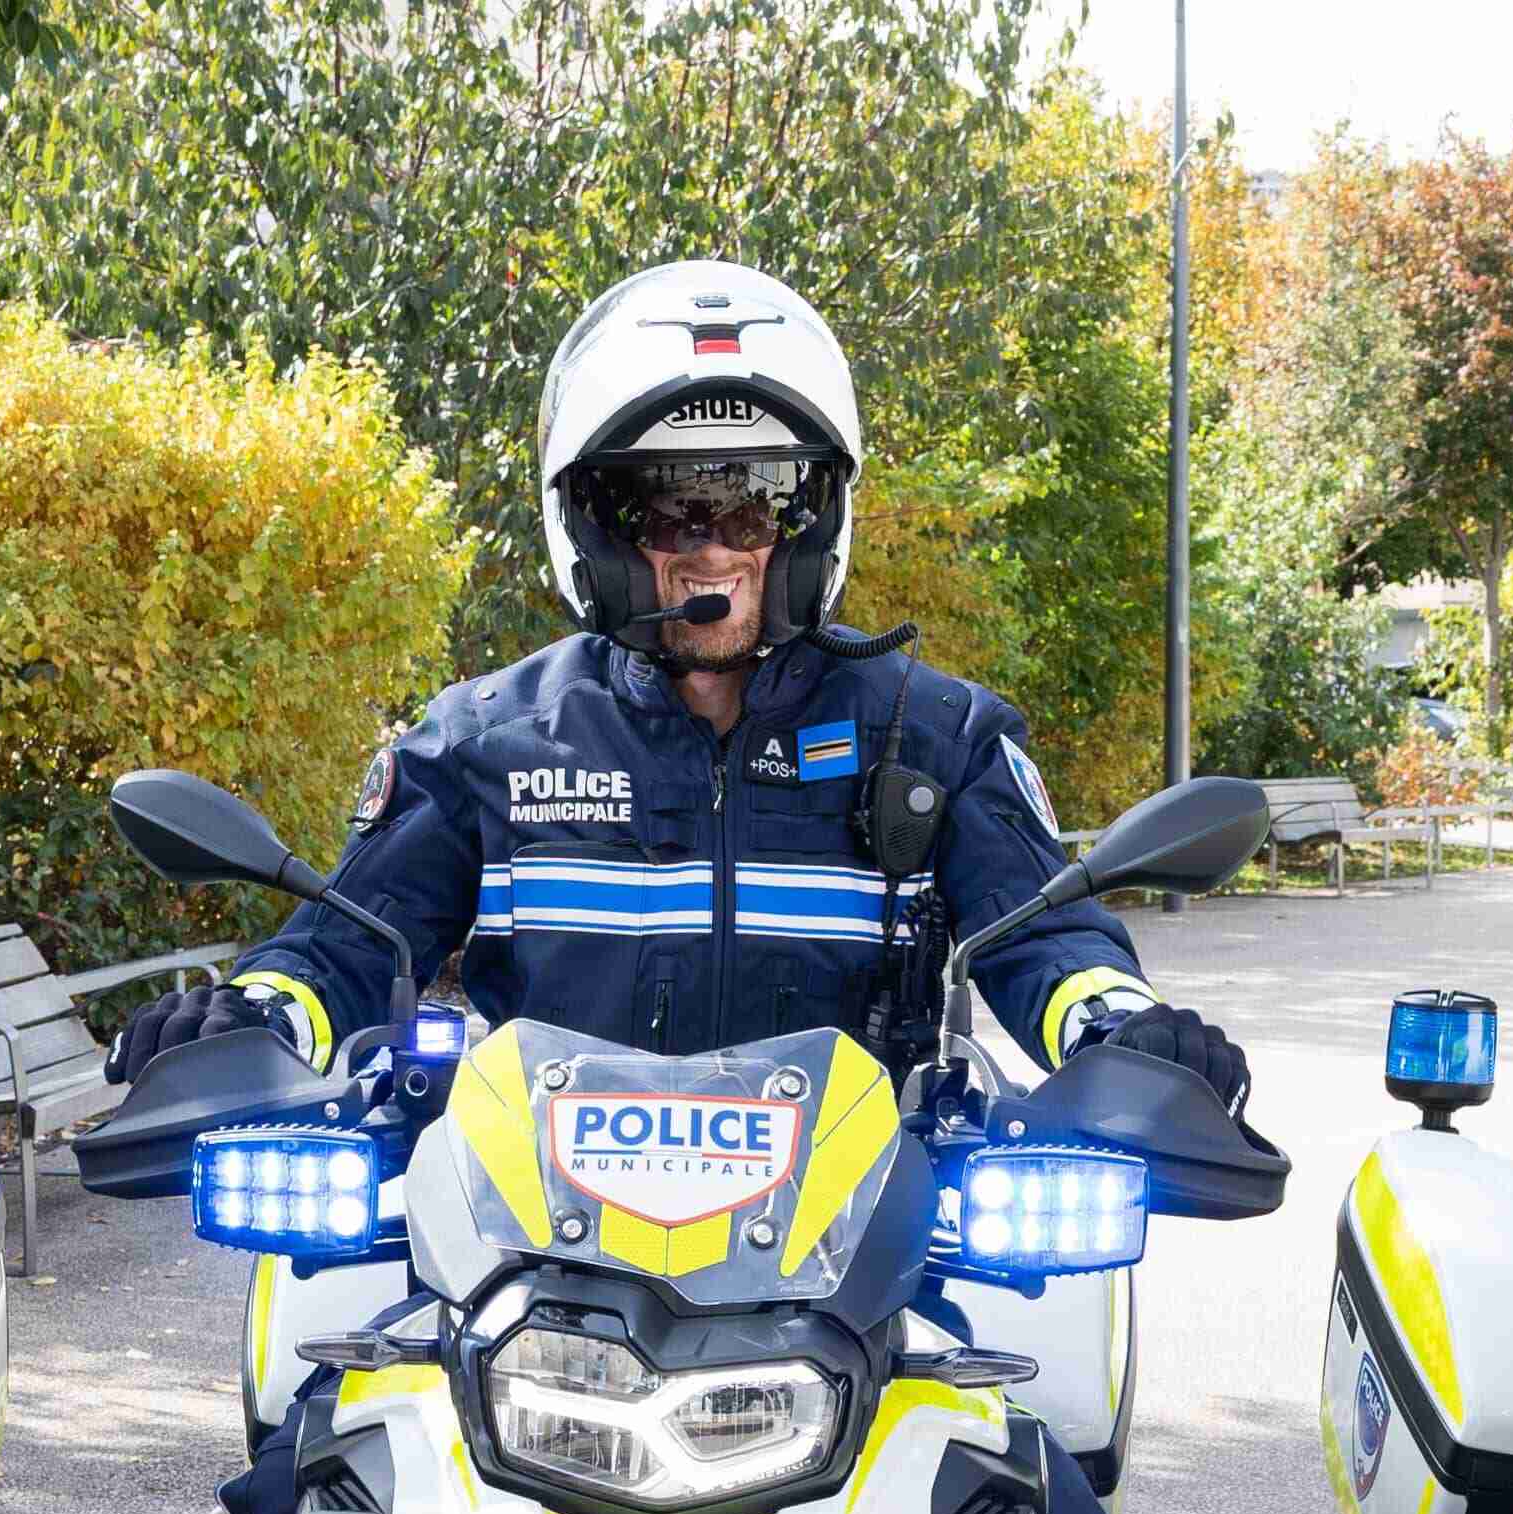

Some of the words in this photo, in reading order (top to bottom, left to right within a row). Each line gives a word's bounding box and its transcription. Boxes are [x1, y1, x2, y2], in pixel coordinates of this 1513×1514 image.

[764, 738, 783, 758] A
[508, 768, 632, 802] POLICE
[509, 801, 632, 823] MUNICIPALE
[574, 1105, 773, 1152] POLICE
[571, 1158, 774, 1177] MUNICIPALE
